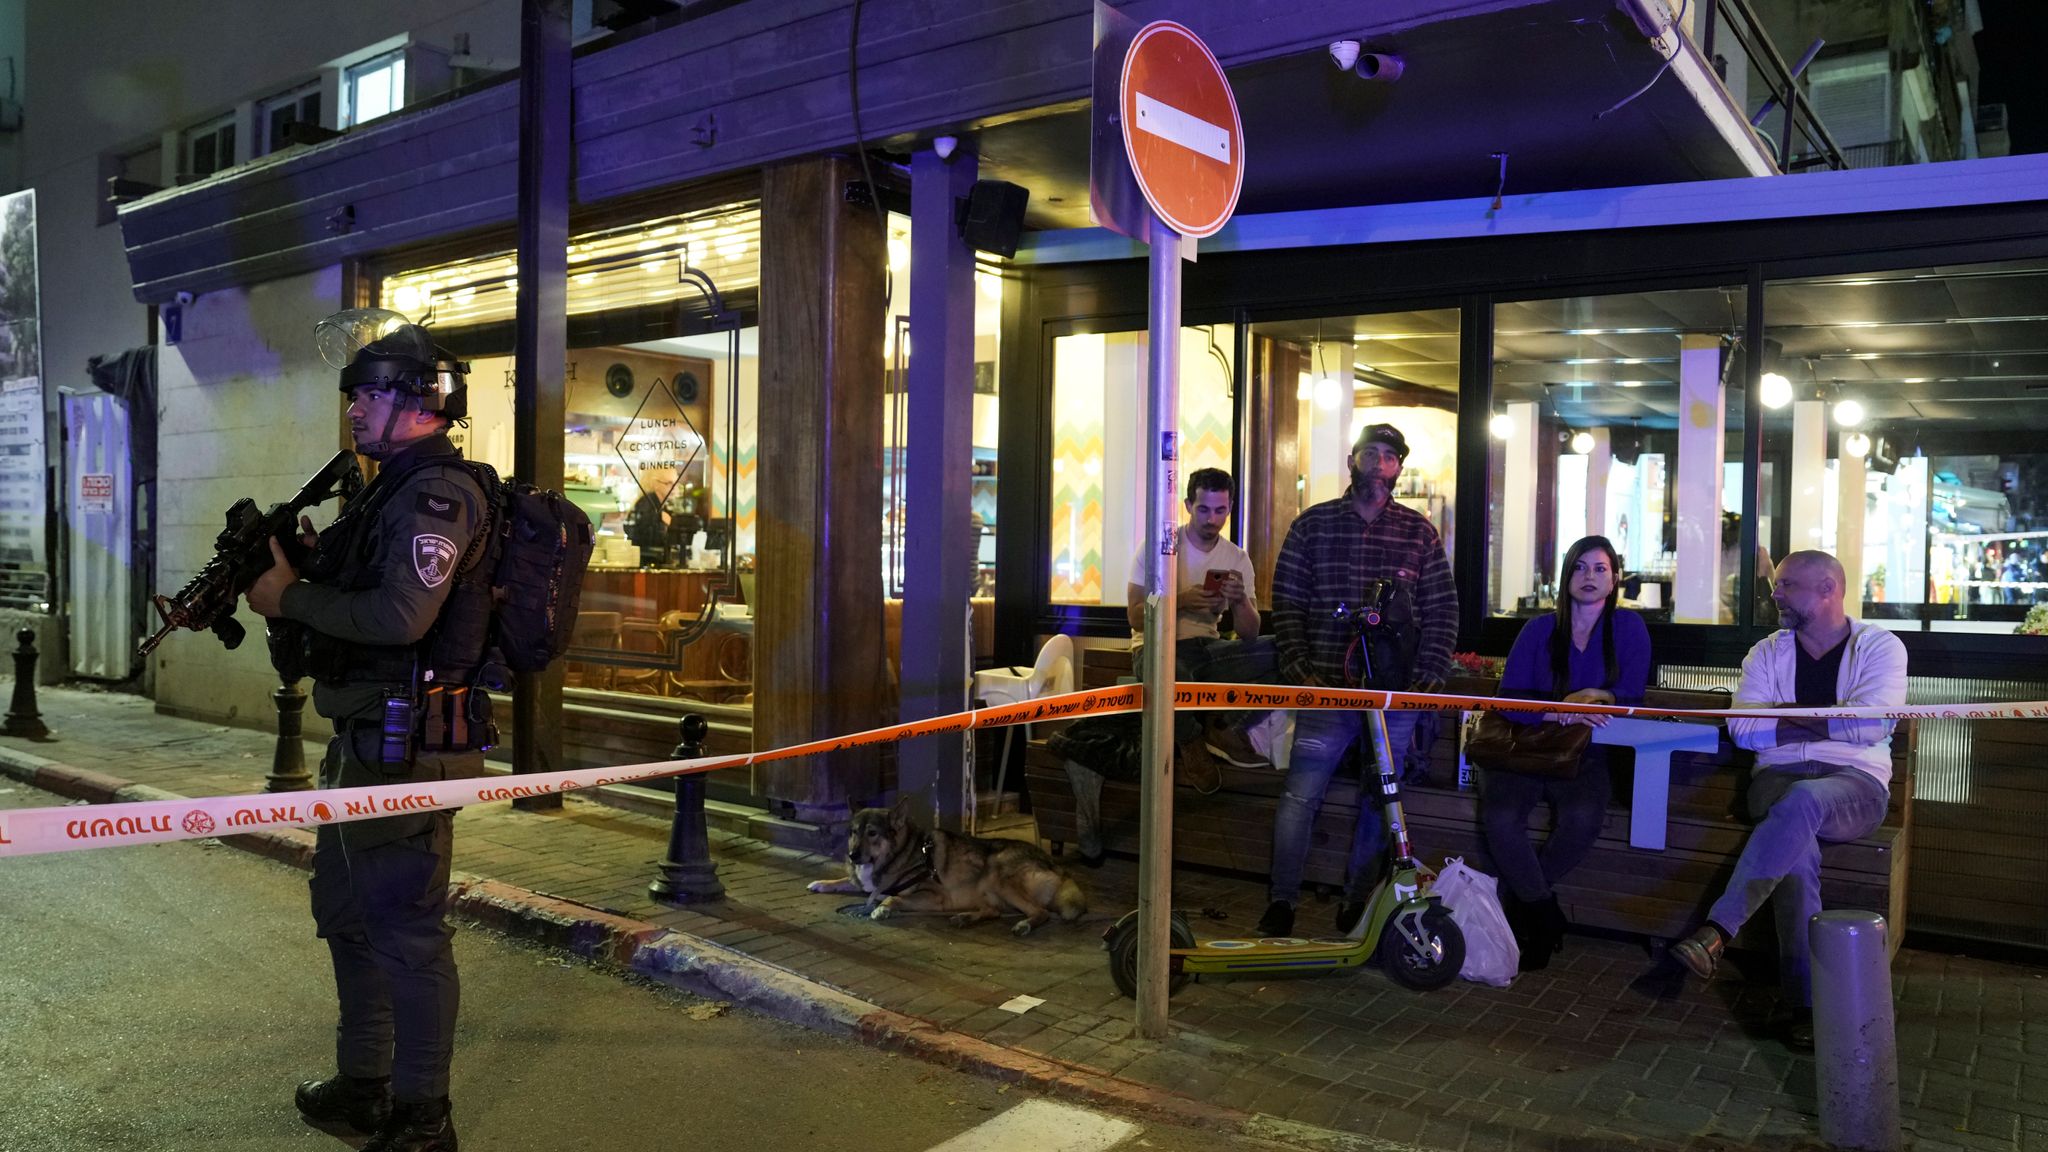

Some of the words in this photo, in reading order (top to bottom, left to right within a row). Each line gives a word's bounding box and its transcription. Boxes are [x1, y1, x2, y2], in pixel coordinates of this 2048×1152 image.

[640, 418, 676, 429] LUNCH
[629, 439, 687, 452] COCKTAILS
[640, 460, 676, 470] DINNER
[1096, 692, 1135, 708] משטרת
[1196, 691, 1218, 706] אין
[1244, 691, 1290, 706] ישראל
[1318, 697, 1375, 708] משטרת
[1048, 702, 1080, 717] ישראל
[66, 814, 173, 840] משטרת
[226, 805, 306, 827] ישראל
[344, 795, 378, 815] אין
[382, 794, 444, 813] מעבר
